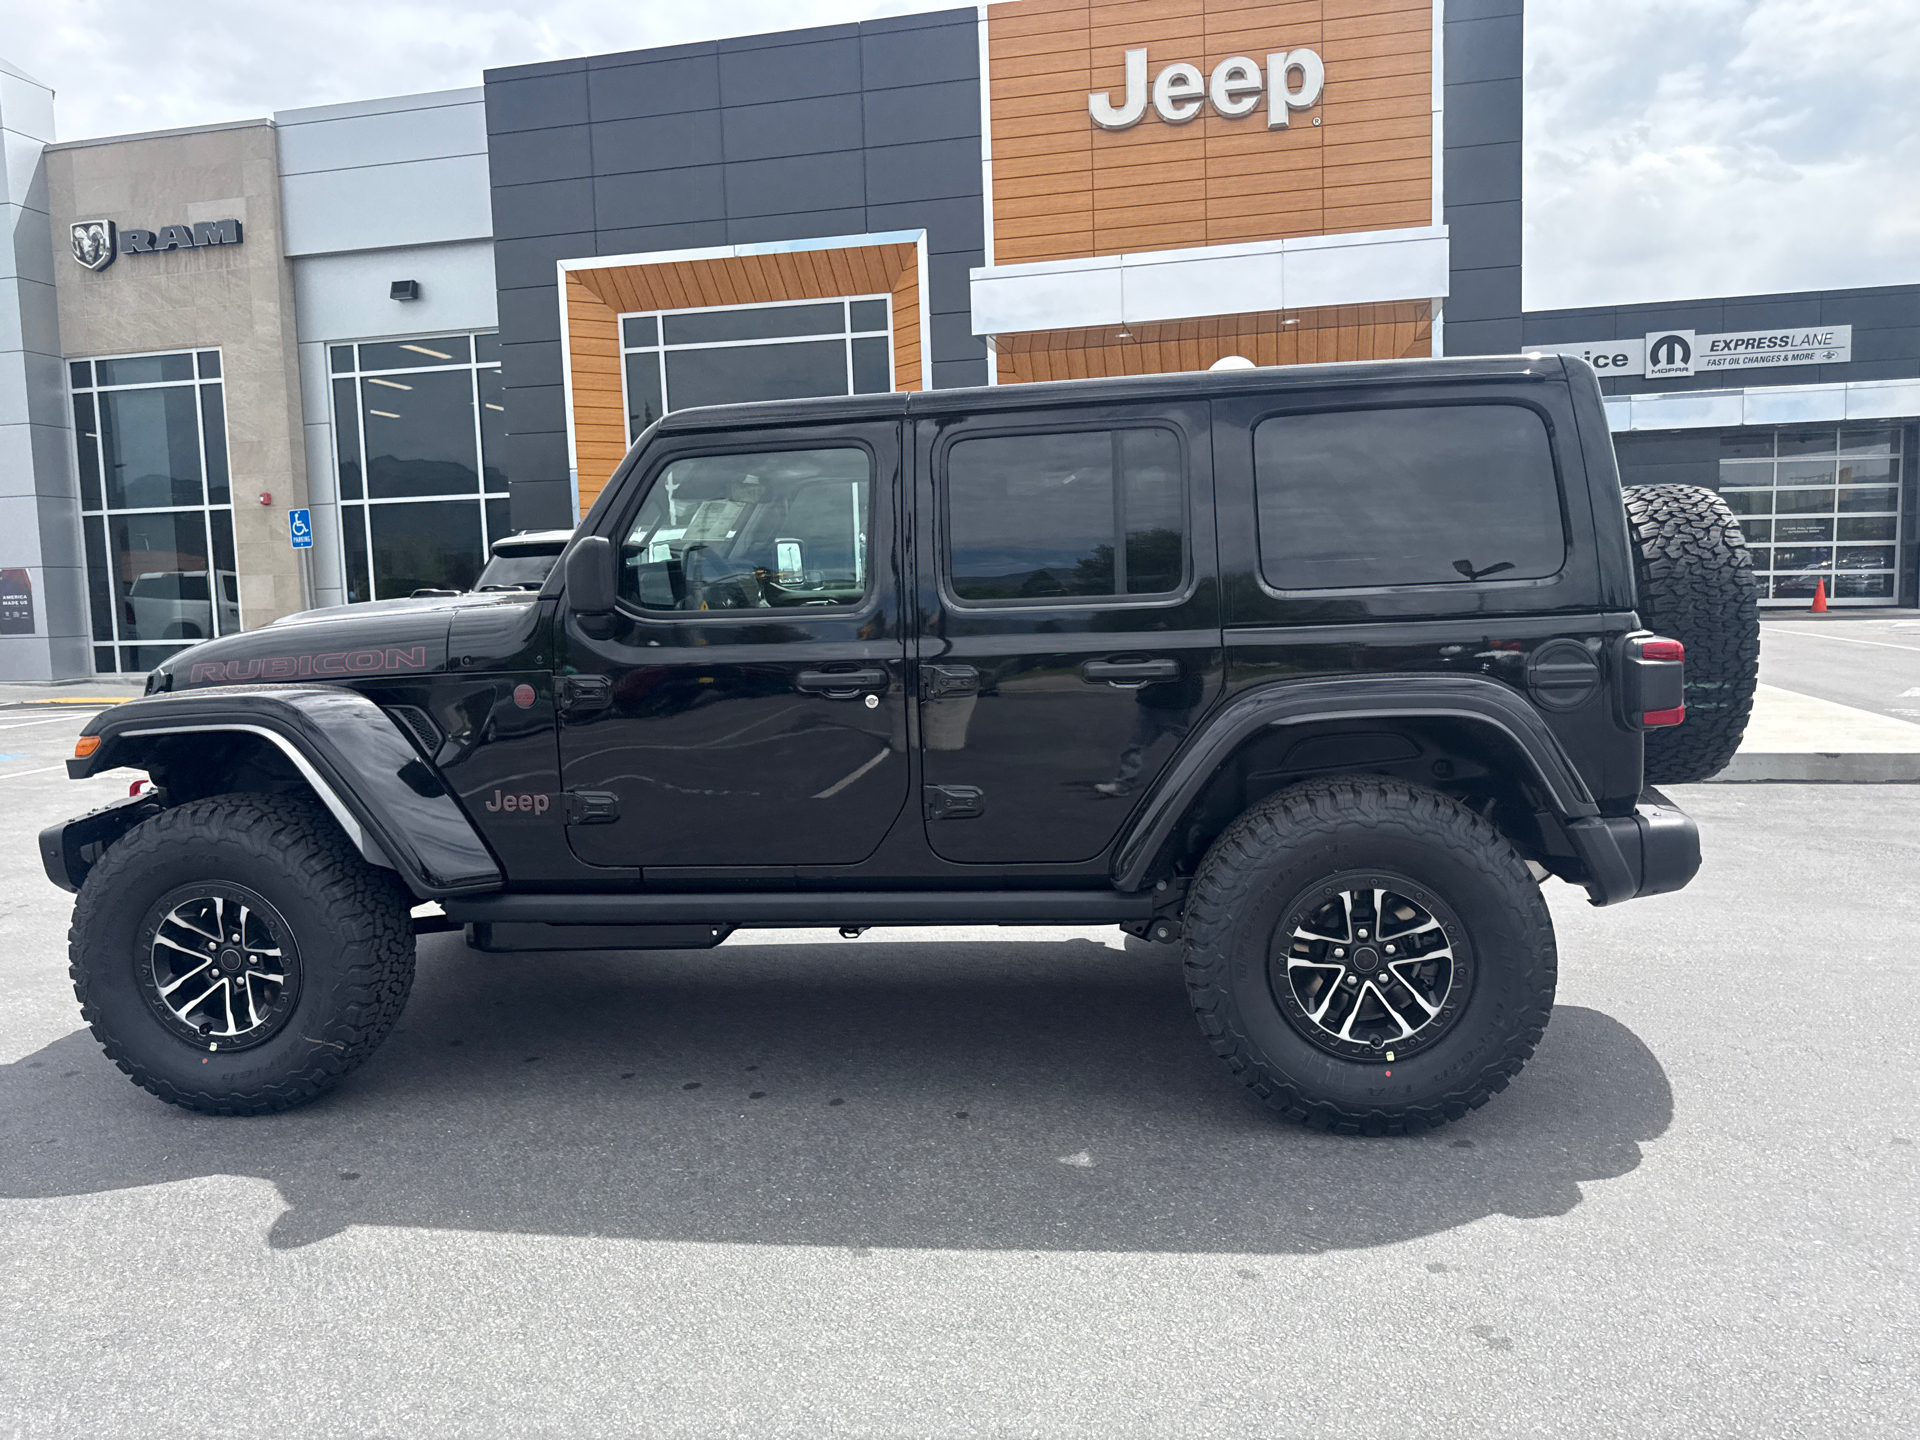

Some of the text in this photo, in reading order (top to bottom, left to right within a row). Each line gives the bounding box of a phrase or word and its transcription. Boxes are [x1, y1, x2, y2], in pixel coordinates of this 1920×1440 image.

[1088, 47, 1325, 131] Jeep
[118, 219, 243, 254] RAM
[1709, 331, 1834, 352] EXPRESSLANE
[1581, 350, 1629, 369] ice
[1706, 358, 1727, 367] FAST
[1728, 357, 1741, 366] OIL
[1742, 355, 1782, 364] CHANGES
[1790, 353, 1815, 361] MORE
[1651, 367, 1689, 375] MOPAR
[293, 535, 311, 543] PARKING
[190, 646, 426, 684] RUBICON
[485, 789, 550, 816] Jeep
